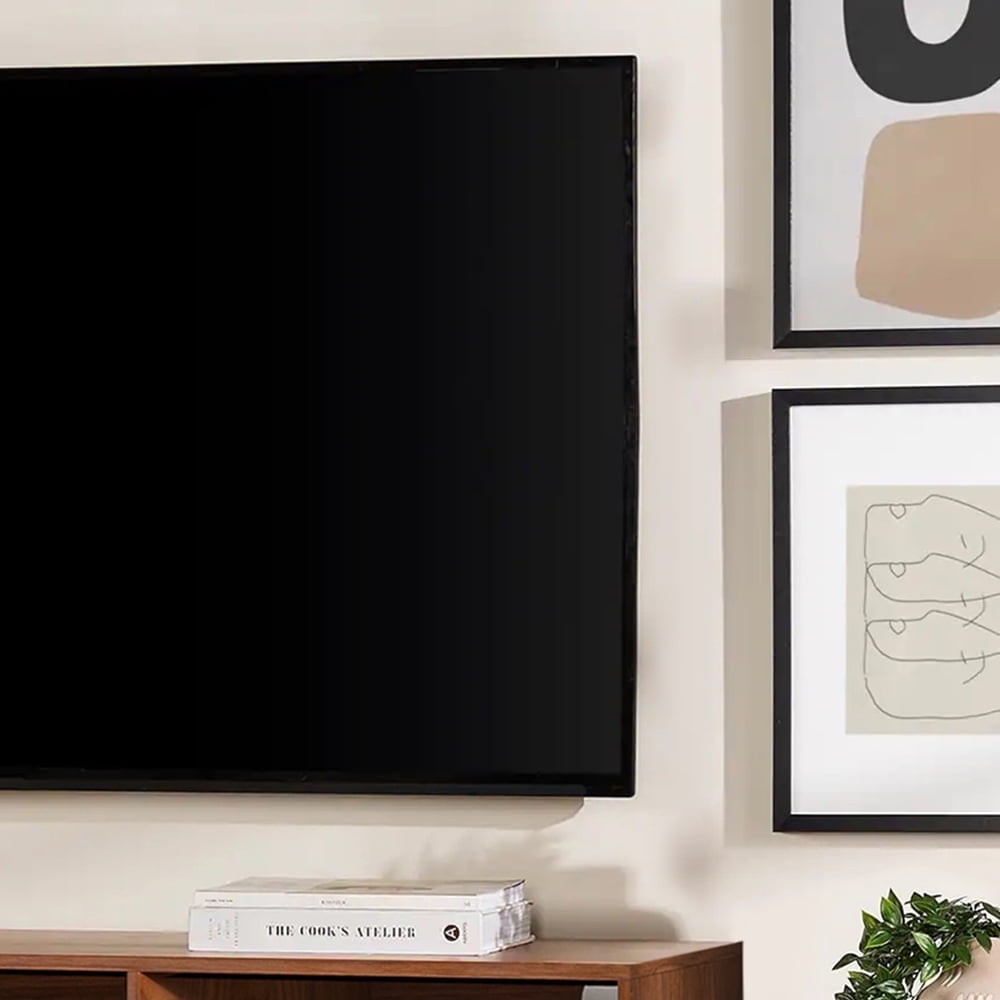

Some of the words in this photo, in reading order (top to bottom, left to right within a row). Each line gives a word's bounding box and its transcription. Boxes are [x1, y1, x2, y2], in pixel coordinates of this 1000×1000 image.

[265, 925, 294, 936] THE
[299, 925, 349, 937] COOK'S
[355, 926, 415, 938] ATELIER
